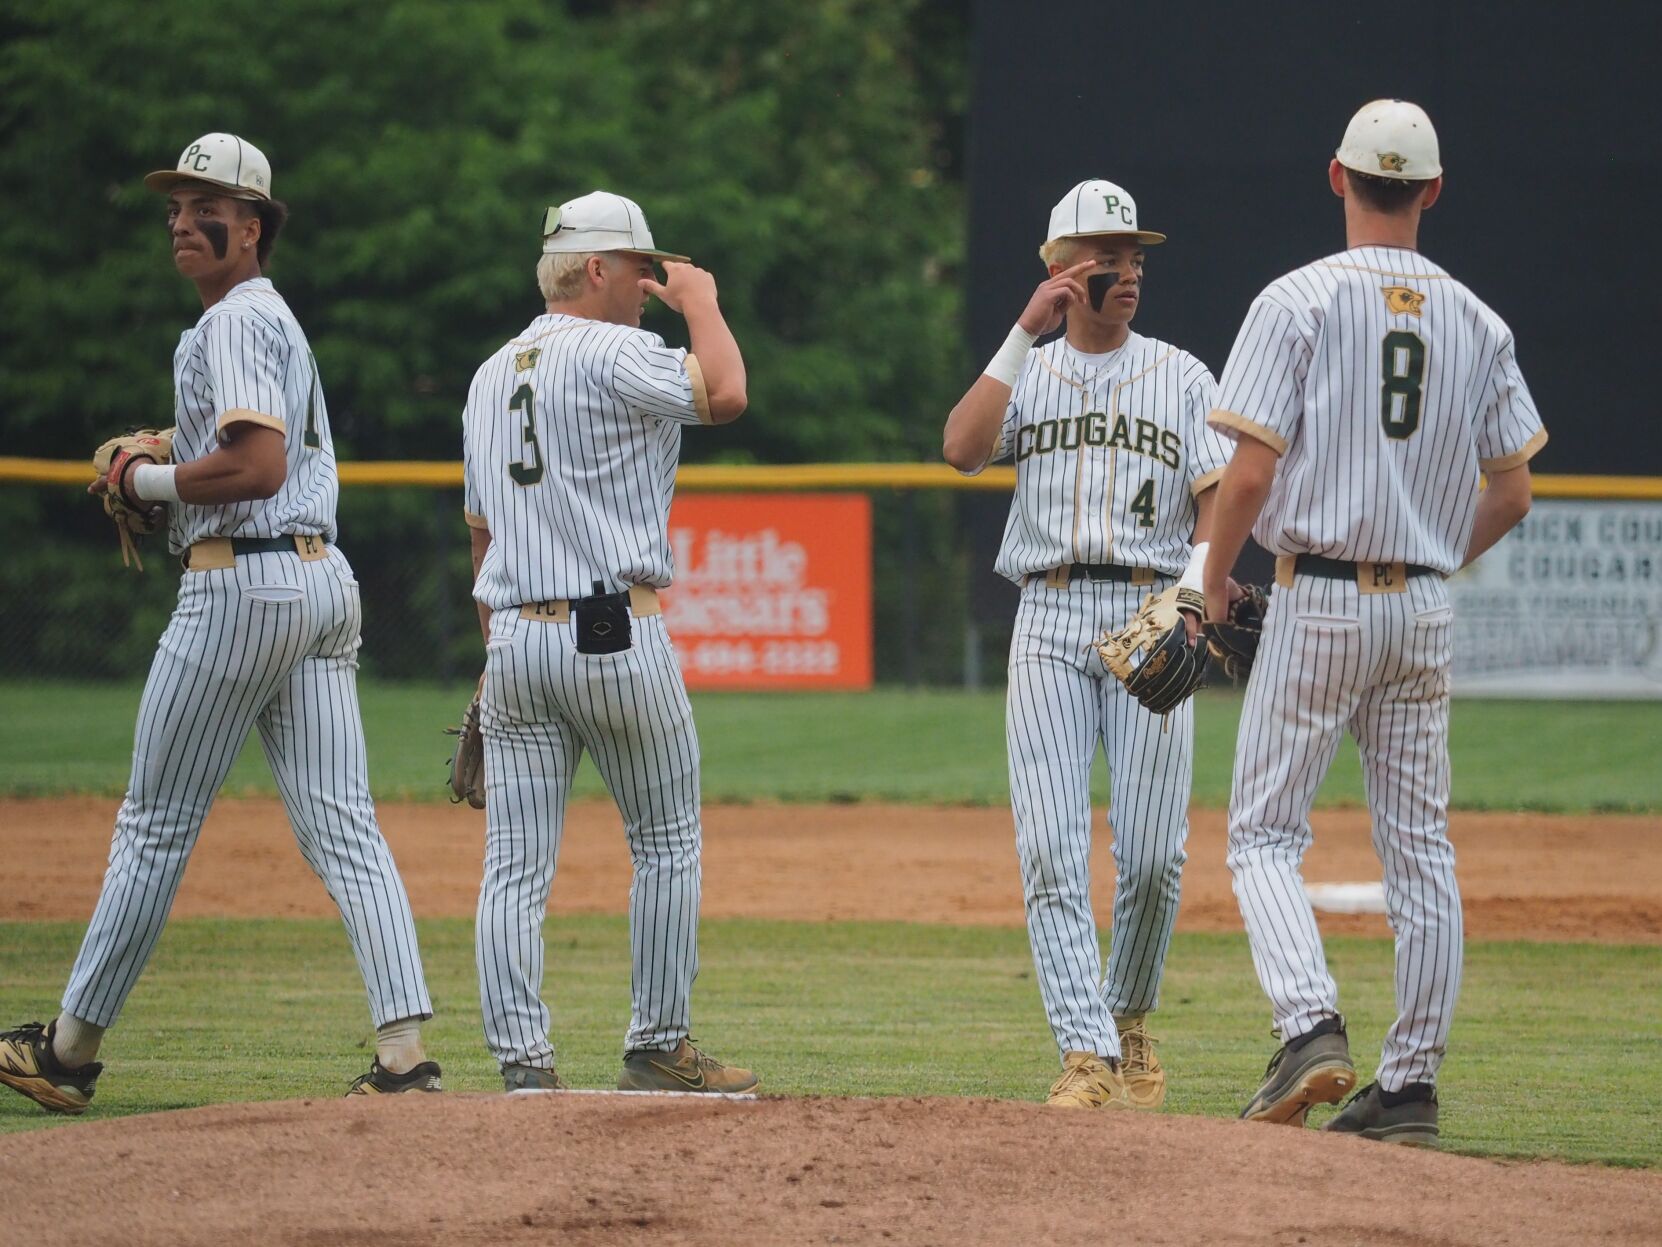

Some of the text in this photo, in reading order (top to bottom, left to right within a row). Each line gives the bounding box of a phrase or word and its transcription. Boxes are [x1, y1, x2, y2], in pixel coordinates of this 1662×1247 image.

[183, 144, 212, 172] PC
[1102, 194, 1133, 226] PC
[1380, 330, 1426, 442] 8
[508, 382, 545, 487] 3
[1015, 411, 1182, 471] COUGARS
[1129, 477, 1157, 530] 4
[1597, 510, 1662, 546] COU
[672, 525, 807, 585] Little
[1372, 562, 1393, 587] PC
[1508, 552, 1662, 586] COUGAR
[662, 587, 832, 637] aesars
